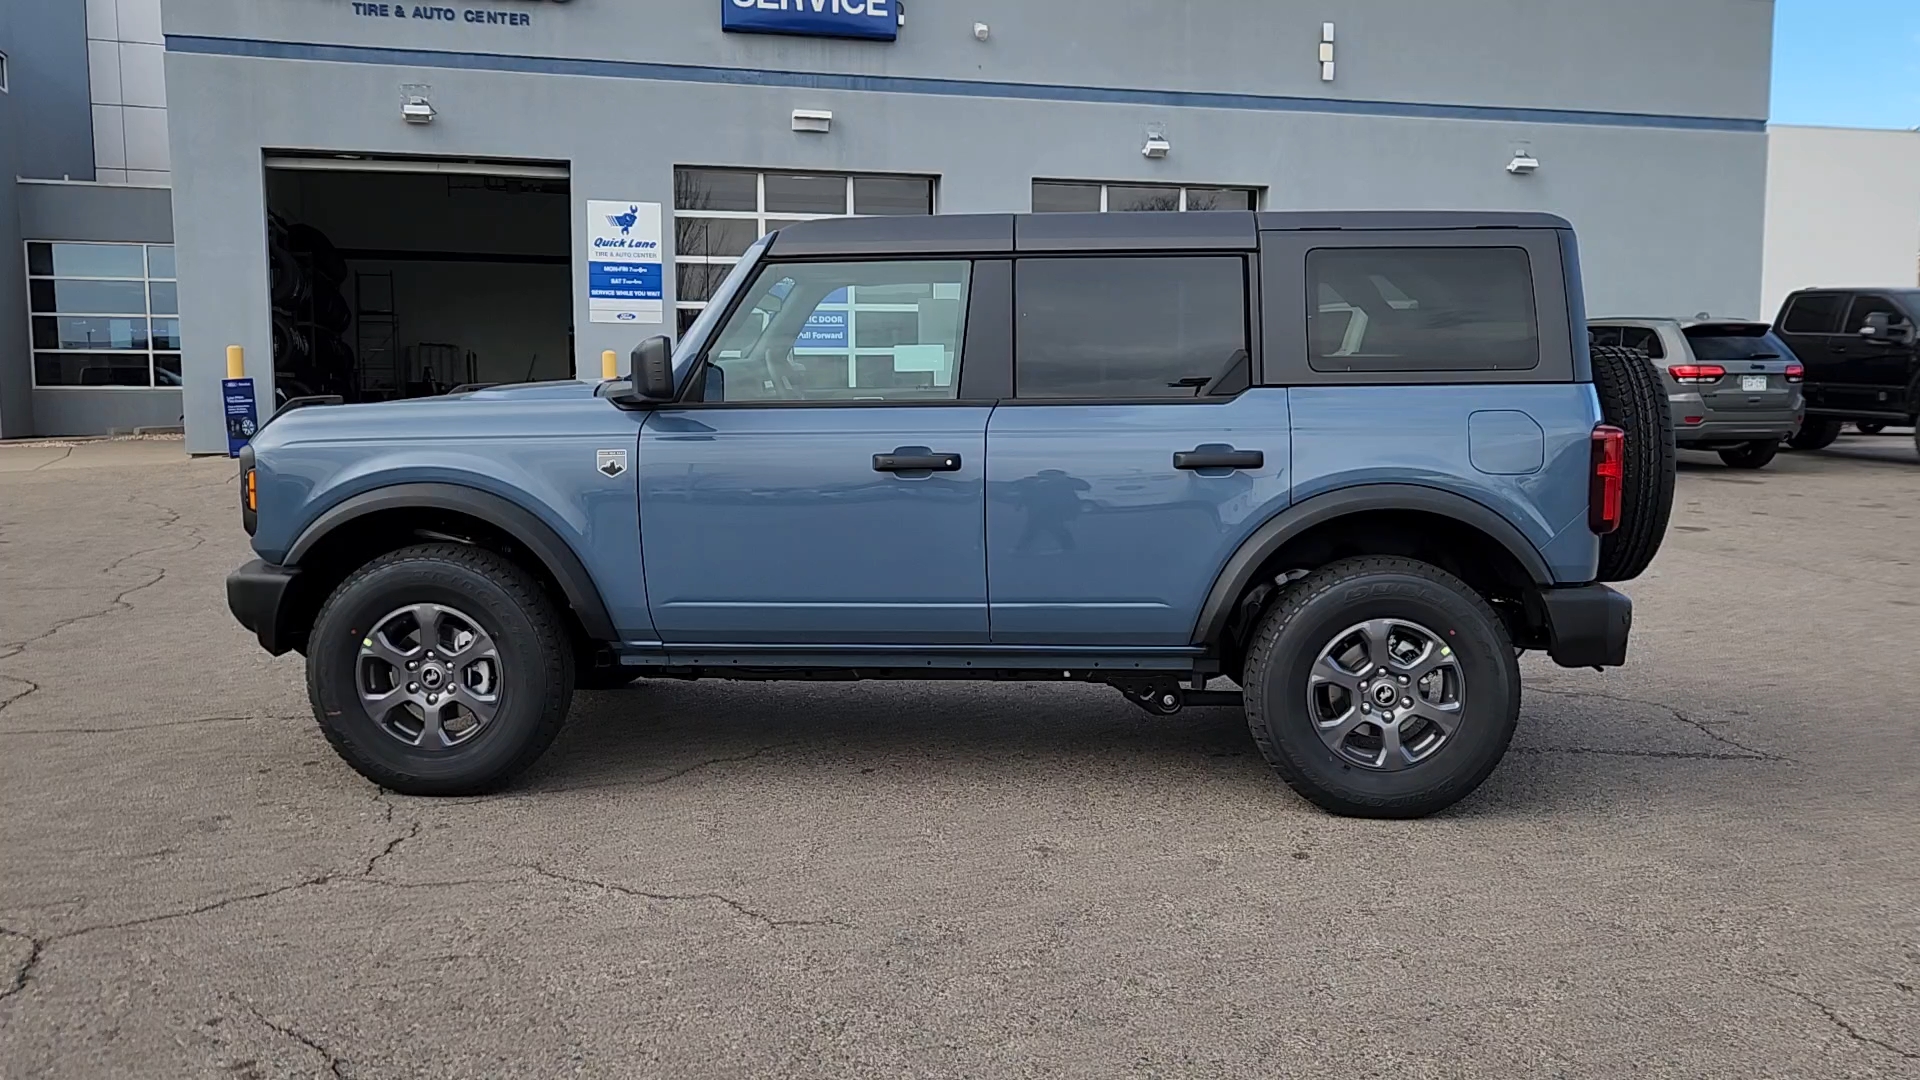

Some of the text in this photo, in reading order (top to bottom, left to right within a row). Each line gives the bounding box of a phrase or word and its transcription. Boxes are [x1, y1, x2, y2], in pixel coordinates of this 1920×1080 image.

[731, 0, 888, 16] VICE
[352, 2, 530, 26] TIRE & AUTO CENTER
[594, 237, 657, 248] Quick Lane
[819, 315, 843, 324] DOOR
[812, 331, 843, 339] Forward
